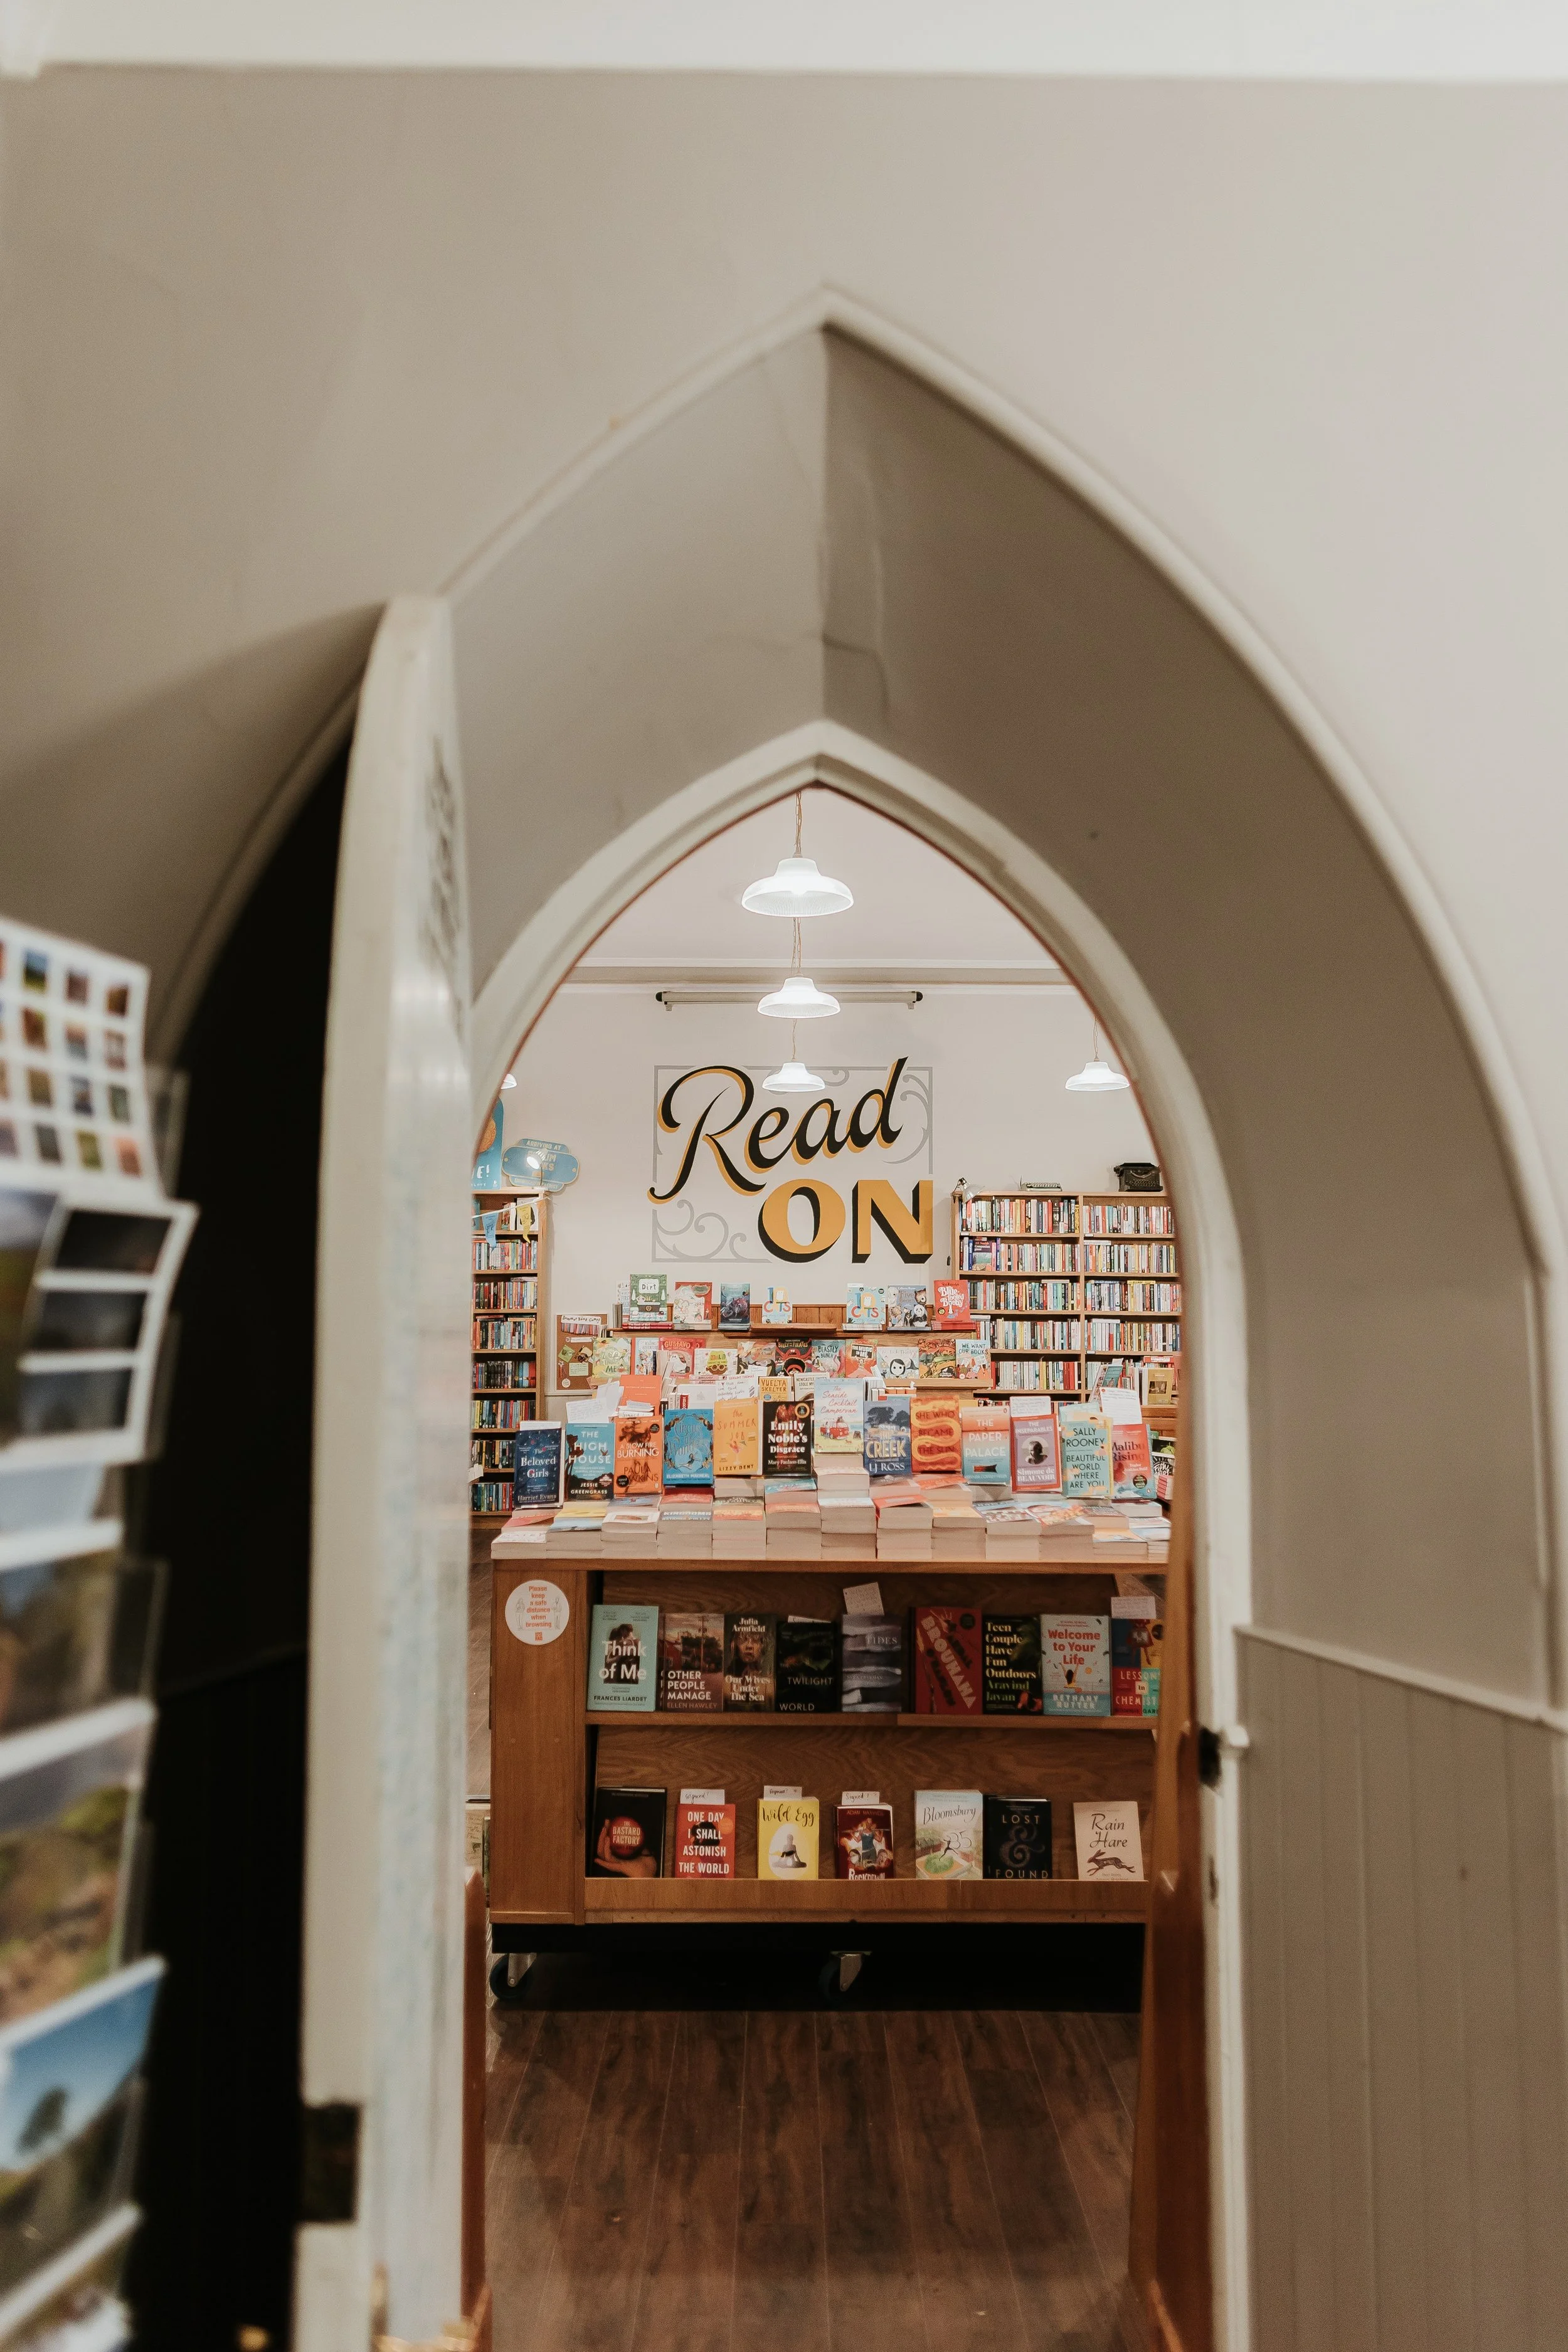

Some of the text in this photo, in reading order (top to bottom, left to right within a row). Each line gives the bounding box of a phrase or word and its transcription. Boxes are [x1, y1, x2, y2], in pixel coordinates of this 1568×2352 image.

[647, 1056, 909, 1205] Read
[758, 1179, 933, 1264] ON
[940, 1298, 964, 1308] Booby
[664, 1340, 690, 1348] GUSTAVO
[818, 1345, 839, 1353] BEASTLY
[820, 1406, 857, 1414] Campervan
[718, 1418, 757, 1430] SUMMER
[771, 1421, 805, 1433] Emily
[730, 1431, 745, 1441] JOB
[968, 1433, 1002, 1441] PAPER
[1073, 1428, 1097, 1436] SALLY
[574, 1443, 607, 1451] HIGH
[1066, 1438, 1105, 1448] ROONEY
[617, 1448, 659, 1458] BURNING
[770, 1445, 805, 1454] Disgrace
[866, 1440, 907, 1458] CREEK
[965, 1447, 1006, 1457] PALACE
[521, 1456, 556, 1466] Beloved
[569, 1455, 611, 1464] HOUSE
[623, 1463, 651, 1475] PAULA
[881, 1462, 905, 1471] ROSS
[527, 1469, 549, 1478] Girls
[1017, 1474, 1056, 1482] BEAUVOIR
[739, 1618, 758, 1626] Julia
[733, 1624, 766, 1633] Armfield
[986, 1623, 1012, 1632] Teen
[985, 1634, 1024, 1645] Couple
[1047, 1629, 1101, 1640] Welcome
[602, 1640, 647, 1656] Think
[986, 1645, 1014, 1655] Have
[1053, 1642, 1096, 1652] to Your
[921, 1616, 977, 1709] BROUHAHA
[986, 1656, 1007, 1666] Fun
[1062, 1654, 1085, 1665] Life
[599, 1663, 647, 1680] of Me
[668, 1671, 701, 1680] OTHER
[986, 1668, 1037, 1679] Outdoors
[1120, 1670, 1159, 1680] LESSON
[744, 1675, 770, 1683] Wives
[668, 1681, 706, 1690] PEOPLE
[733, 1683, 760, 1692] Under
[988, 1680, 1029, 1690] Aravind
[668, 1692, 711, 1700] MANAGE
[730, 1692, 765, 1702] The Sea
[1116, 1696, 1157, 1705] CHEMIST
[687, 1811, 724, 1823] ONE DAY
[762, 1804, 815, 1827] Wild Egg
[923, 1804, 977, 1825] Bloomsbury
[1002, 1814, 1041, 1825] LOST
[1091, 1813, 1125, 1831] Rain
[613, 1826, 640, 1836] BASTARD
[687, 1828, 723, 1840] I SHALL
[613, 1836, 640, 1845] FACTORY
[950, 1831, 972, 1850] 35
[1089, 1831, 1128, 1848] Hare
[682, 1845, 726, 1857] ASTONISH
[999, 1824, 1046, 1868] &
[679, 1862, 729, 1874] THE WORLD
[995, 1869, 1049, 1879] FOUND
